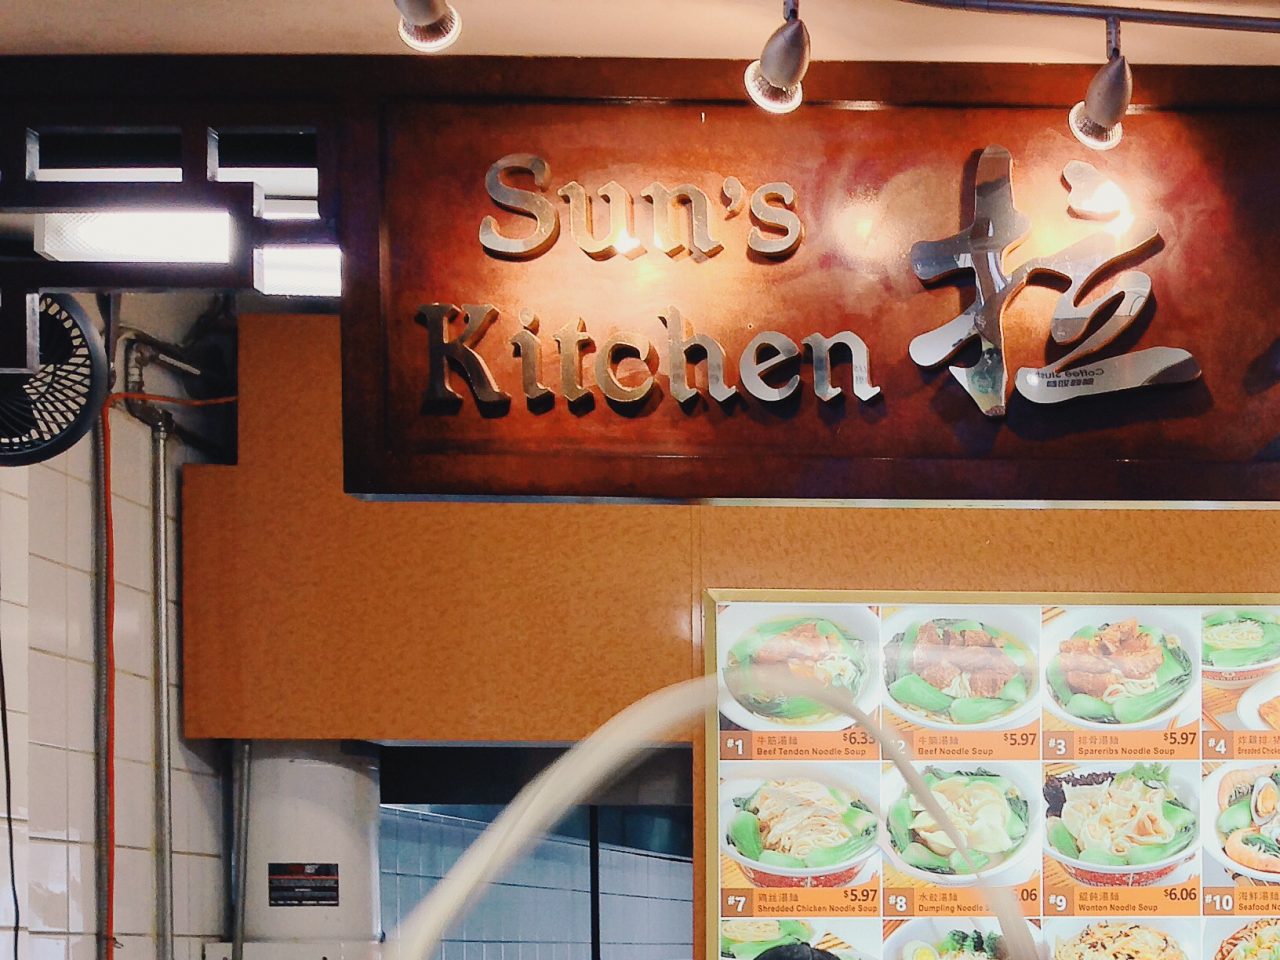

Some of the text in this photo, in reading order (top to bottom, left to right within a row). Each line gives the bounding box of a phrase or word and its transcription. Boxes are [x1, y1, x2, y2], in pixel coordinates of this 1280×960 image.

[478, 153, 803, 262] Sun's
[415, 302, 881, 408] Kitchen
[1003, 733, 1037, 746] $5.97
[1163, 732, 1197, 745] $5.97
[726, 738, 743, 755] #1
[845, 748, 866, 756] Soup
[972, 748, 993, 756] Soup
[1048, 737, 1066, 755] #3
[1078, 748, 1118, 756] Spareribs
[1153, 748, 1175, 756] Soup
[1208, 737, 1226, 754] #4
[843, 889, 877, 902] $5.97
[1164, 888, 1197, 901] $6.06
[727, 895, 746, 912] #7
[858, 905, 877, 913] Soup
[888, 895, 907, 912] #8
[919, 905, 955, 913] Dumpling
[1048, 894, 1066, 911] #9
[1138, 904, 1158, 912] Soup
[1205, 894, 1233, 911] #10
